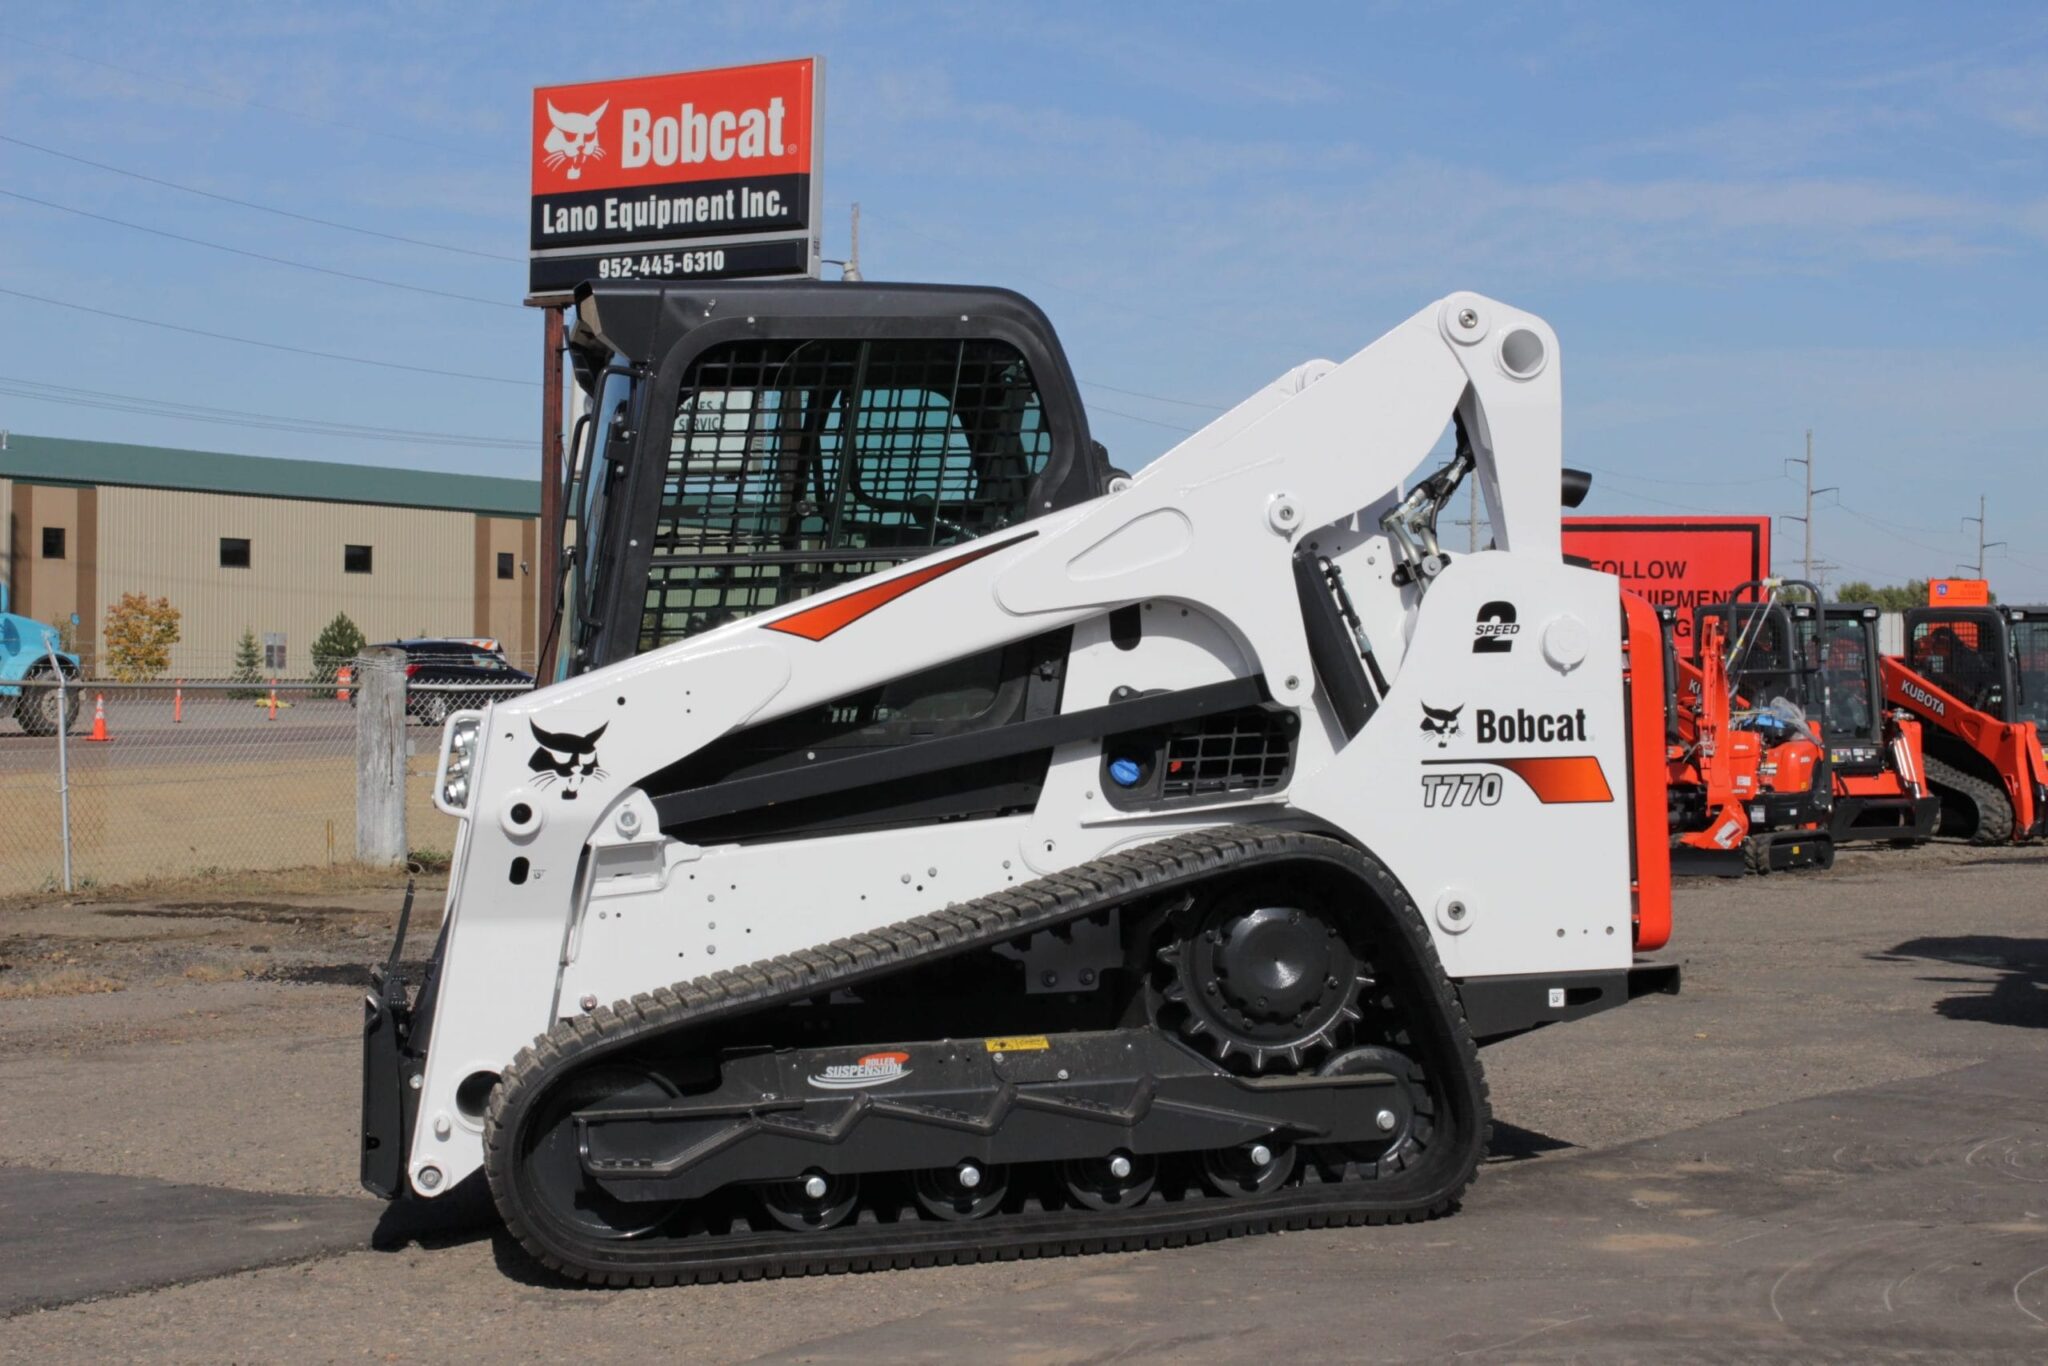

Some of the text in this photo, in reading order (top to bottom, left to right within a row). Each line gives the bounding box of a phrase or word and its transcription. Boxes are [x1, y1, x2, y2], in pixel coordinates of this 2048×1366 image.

[621, 97, 785, 168] Bobcat
[543, 187, 788, 234] Lano Equipment Inc.
[599, 250, 724, 279] 952-445-6310
[1472, 600, 1518, 654] 2
[1475, 624, 1521, 636] SPEED
[1901, 679, 1945, 716] KUBOTA
[1476, 708, 1587, 744] Bobcat
[1421, 772, 1503, 808] T770
[825, 1063, 903, 1078] SUSPENSION
